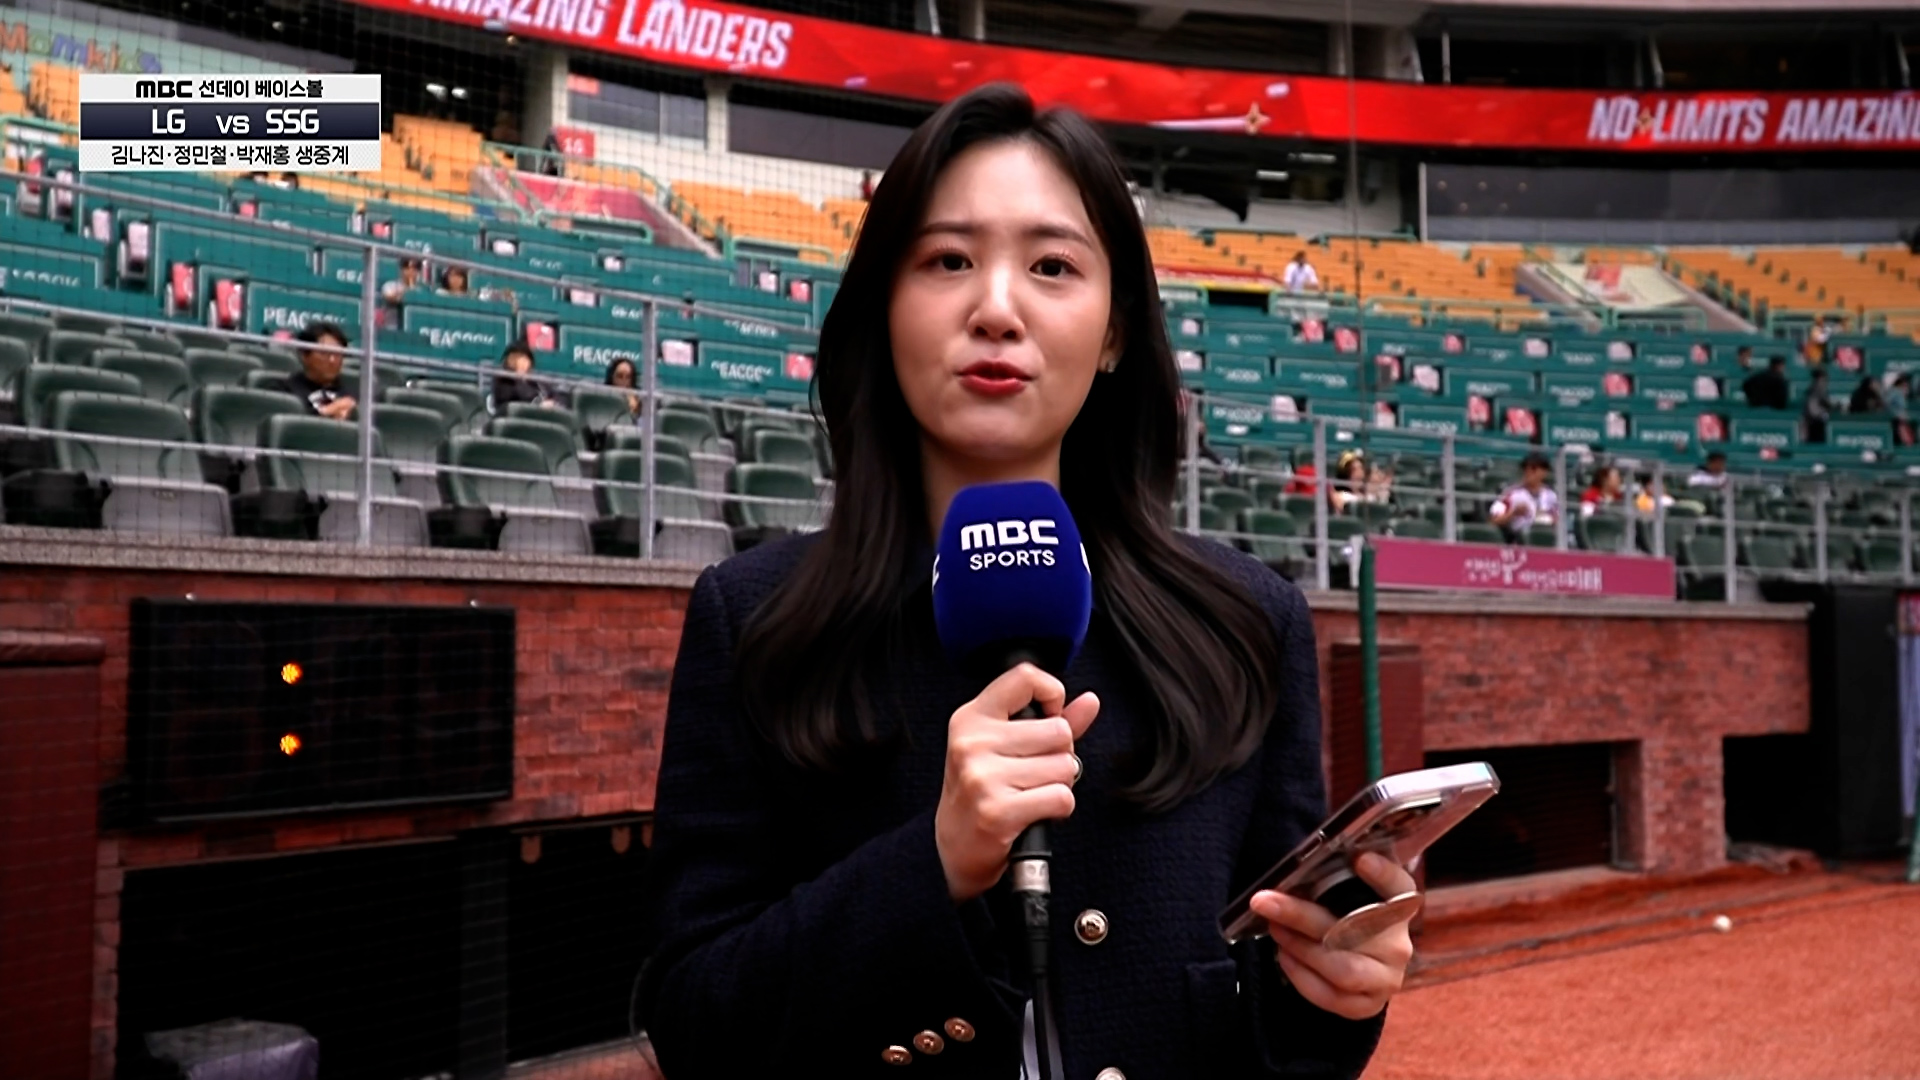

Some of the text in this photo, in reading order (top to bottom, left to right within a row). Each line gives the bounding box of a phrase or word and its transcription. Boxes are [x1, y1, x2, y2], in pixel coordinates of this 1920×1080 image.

[616, 0, 793, 69] LANDERS
[1587, 95, 1639, 142] NO
[1652, 98, 1769, 142] LIMITS
[961, 519, 1059, 551] MBC
[970, 549, 1056, 571] SPORTS
